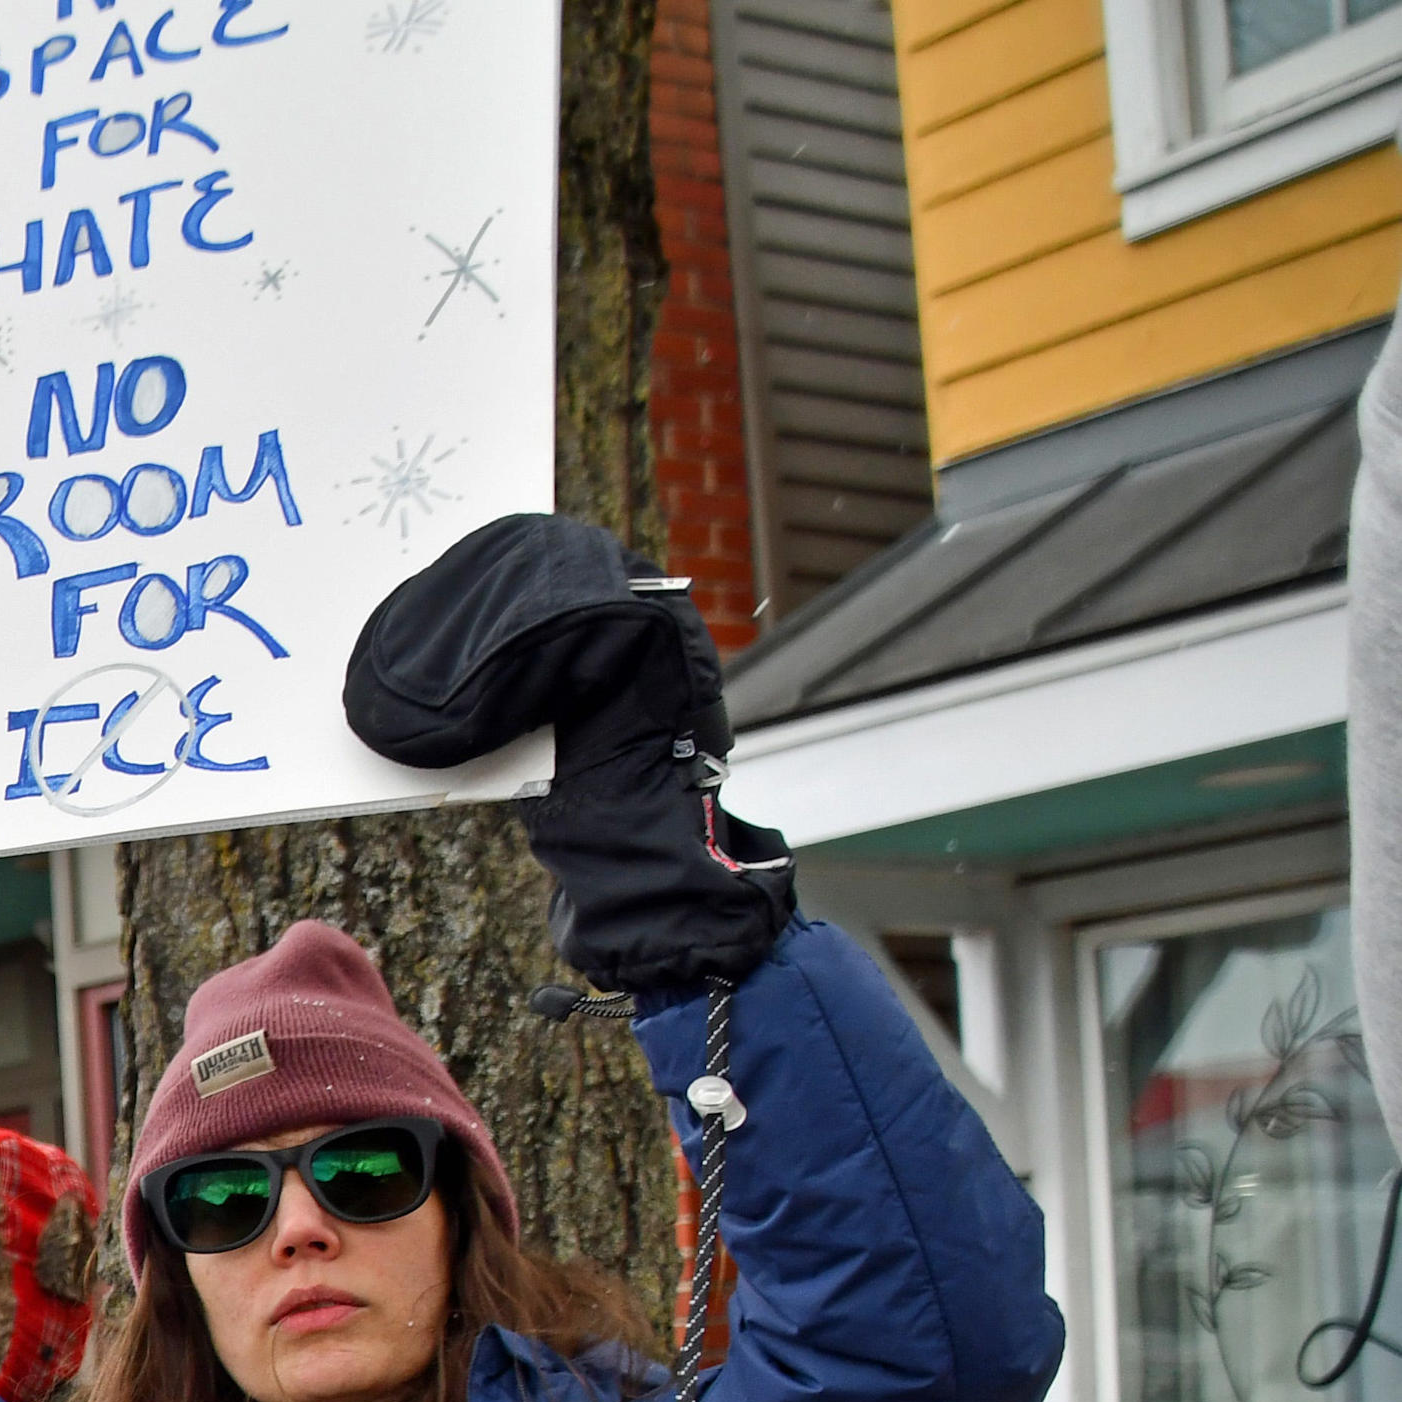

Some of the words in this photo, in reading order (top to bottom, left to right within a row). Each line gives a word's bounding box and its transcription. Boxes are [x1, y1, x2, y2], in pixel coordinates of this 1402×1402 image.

[40, 91, 219, 190] FOR
[26, 354, 187, 459] NO
[52, 554, 291, 660] FOR
[5, 675, 271, 803] ICE
[197, 1036, 264, 1083] DULUTH
